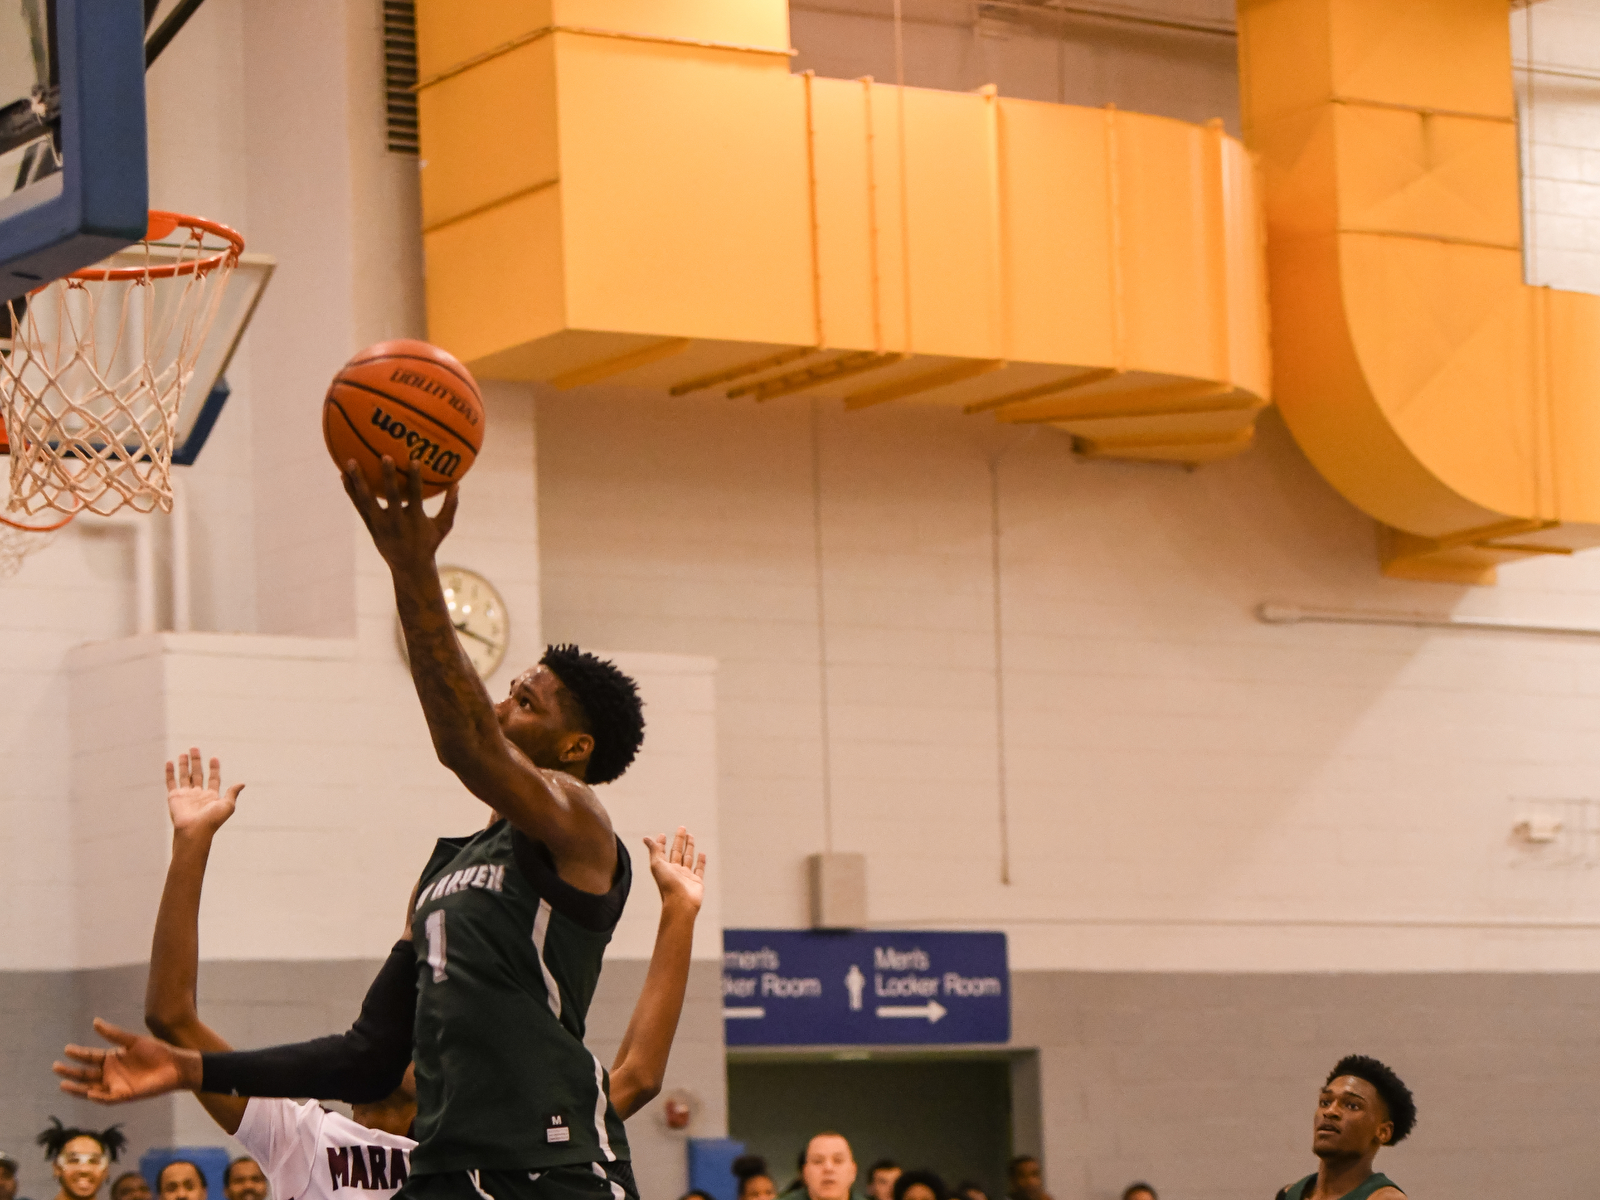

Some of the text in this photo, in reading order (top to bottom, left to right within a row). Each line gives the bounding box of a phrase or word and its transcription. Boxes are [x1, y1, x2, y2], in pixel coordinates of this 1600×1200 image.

[371, 407, 462, 478] Wilson
[429, 863, 505, 902] HAVEN
[425, 908, 450, 985] 1
[874, 946, 931, 972] Men's
[760, 971, 823, 998] Room
[874, 971, 1002, 998] Locker Room
[551, 1114, 563, 1126] M
[326, 1145, 412, 1192] MARA
